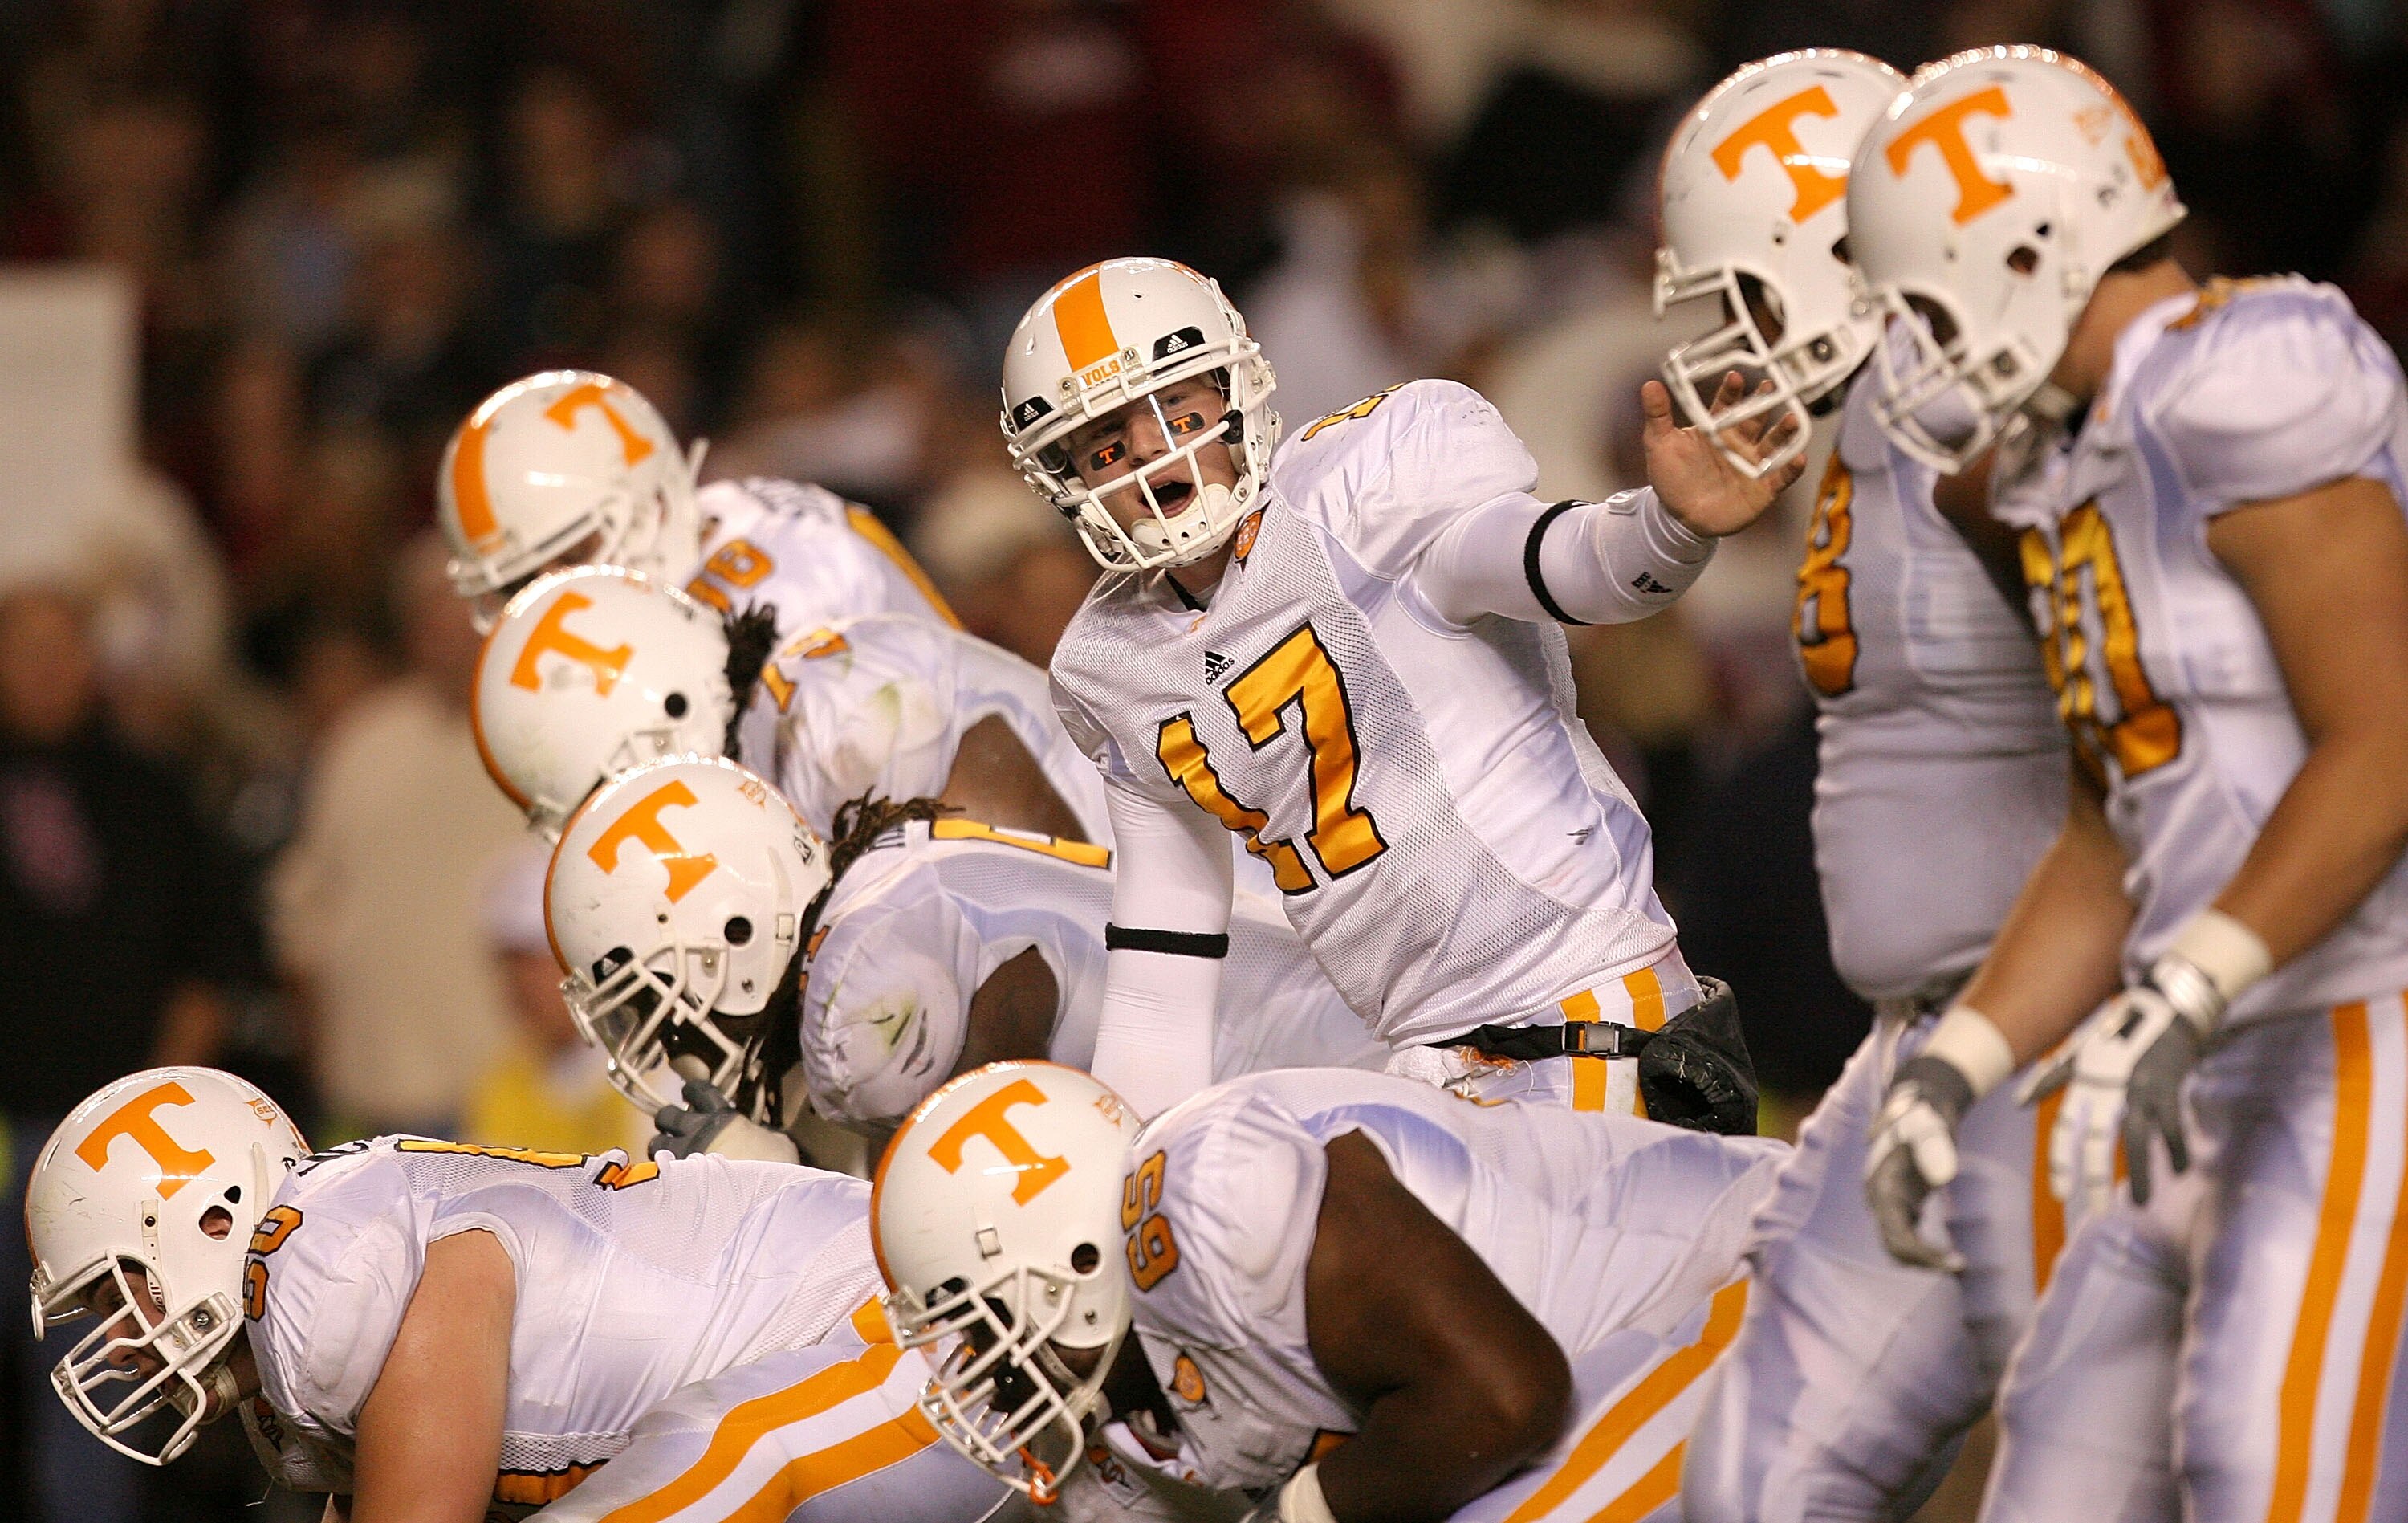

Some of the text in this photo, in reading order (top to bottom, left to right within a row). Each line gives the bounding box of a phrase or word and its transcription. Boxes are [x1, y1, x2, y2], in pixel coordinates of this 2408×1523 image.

[1711, 86, 1849, 225] T
[1885, 86, 2015, 227] T
[1080, 360, 1121, 386] VOLS
[1166, 340, 1189, 353] adidas
[545, 383, 655, 468] T
[1099, 447, 1116, 465] T
[1173, 415, 1191, 433] T
[510, 591, 633, 695] T
[1206, 657, 1235, 685] adidas
[1156, 621, 1390, 896] 17
[587, 780, 717, 904] T
[75, 1081, 216, 1200] T
[927, 1079, 1071, 1207] T
